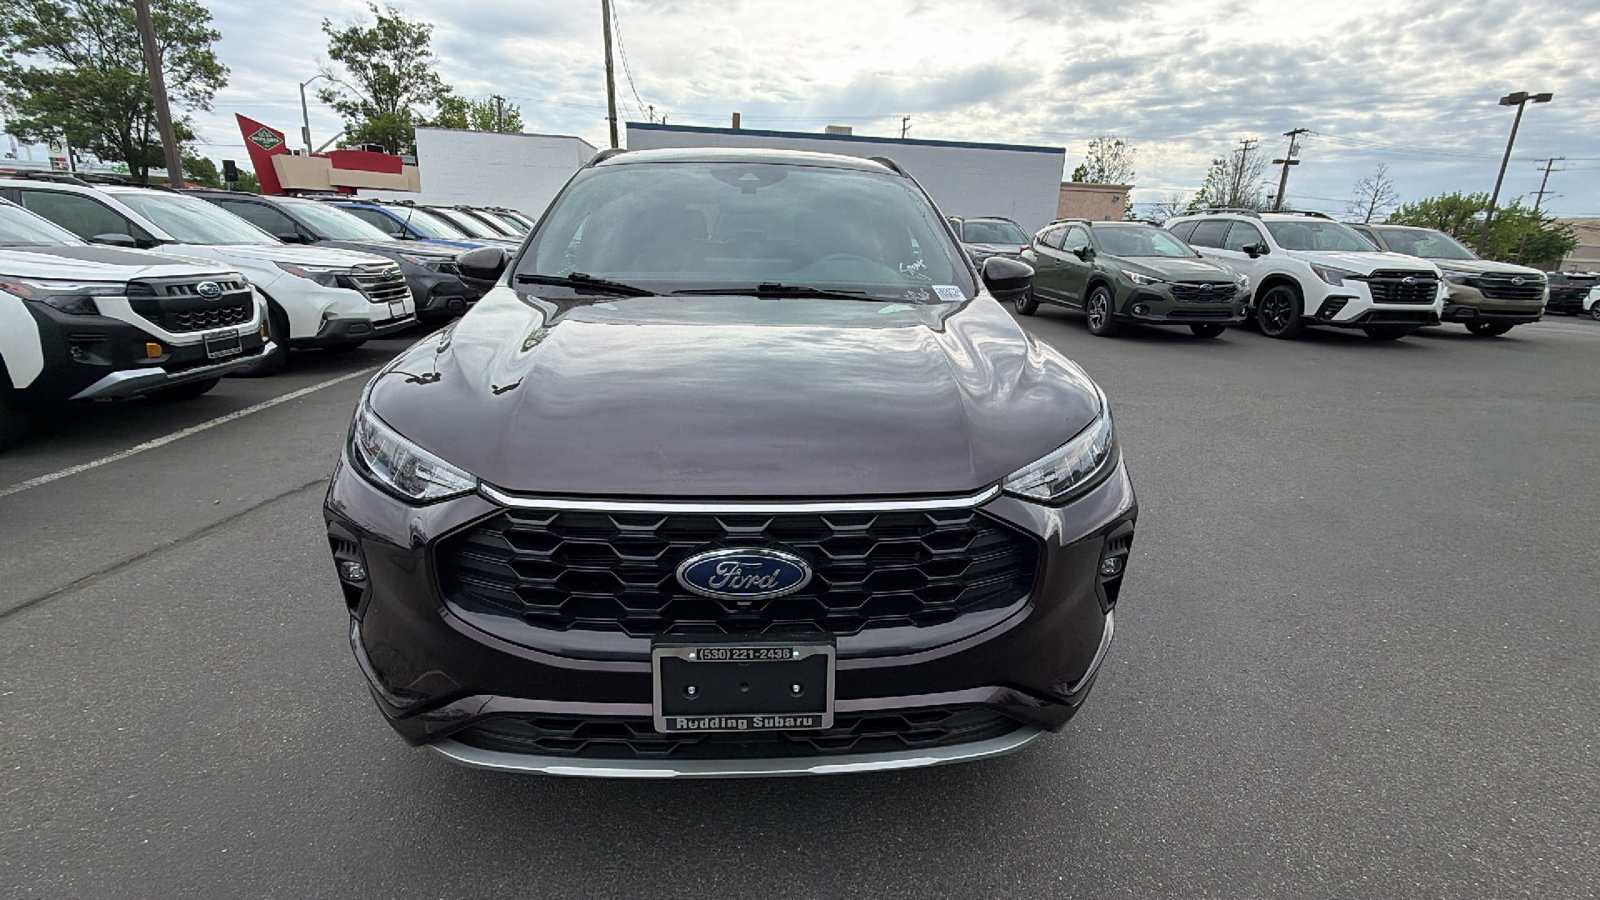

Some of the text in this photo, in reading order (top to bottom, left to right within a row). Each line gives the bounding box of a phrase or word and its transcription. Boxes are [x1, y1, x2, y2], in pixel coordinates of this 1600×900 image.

[708, 561, 781, 589] Ford
[699, 649, 790, 660] (530) 221-2436
[676, 716, 813, 730] Redding Subaru
